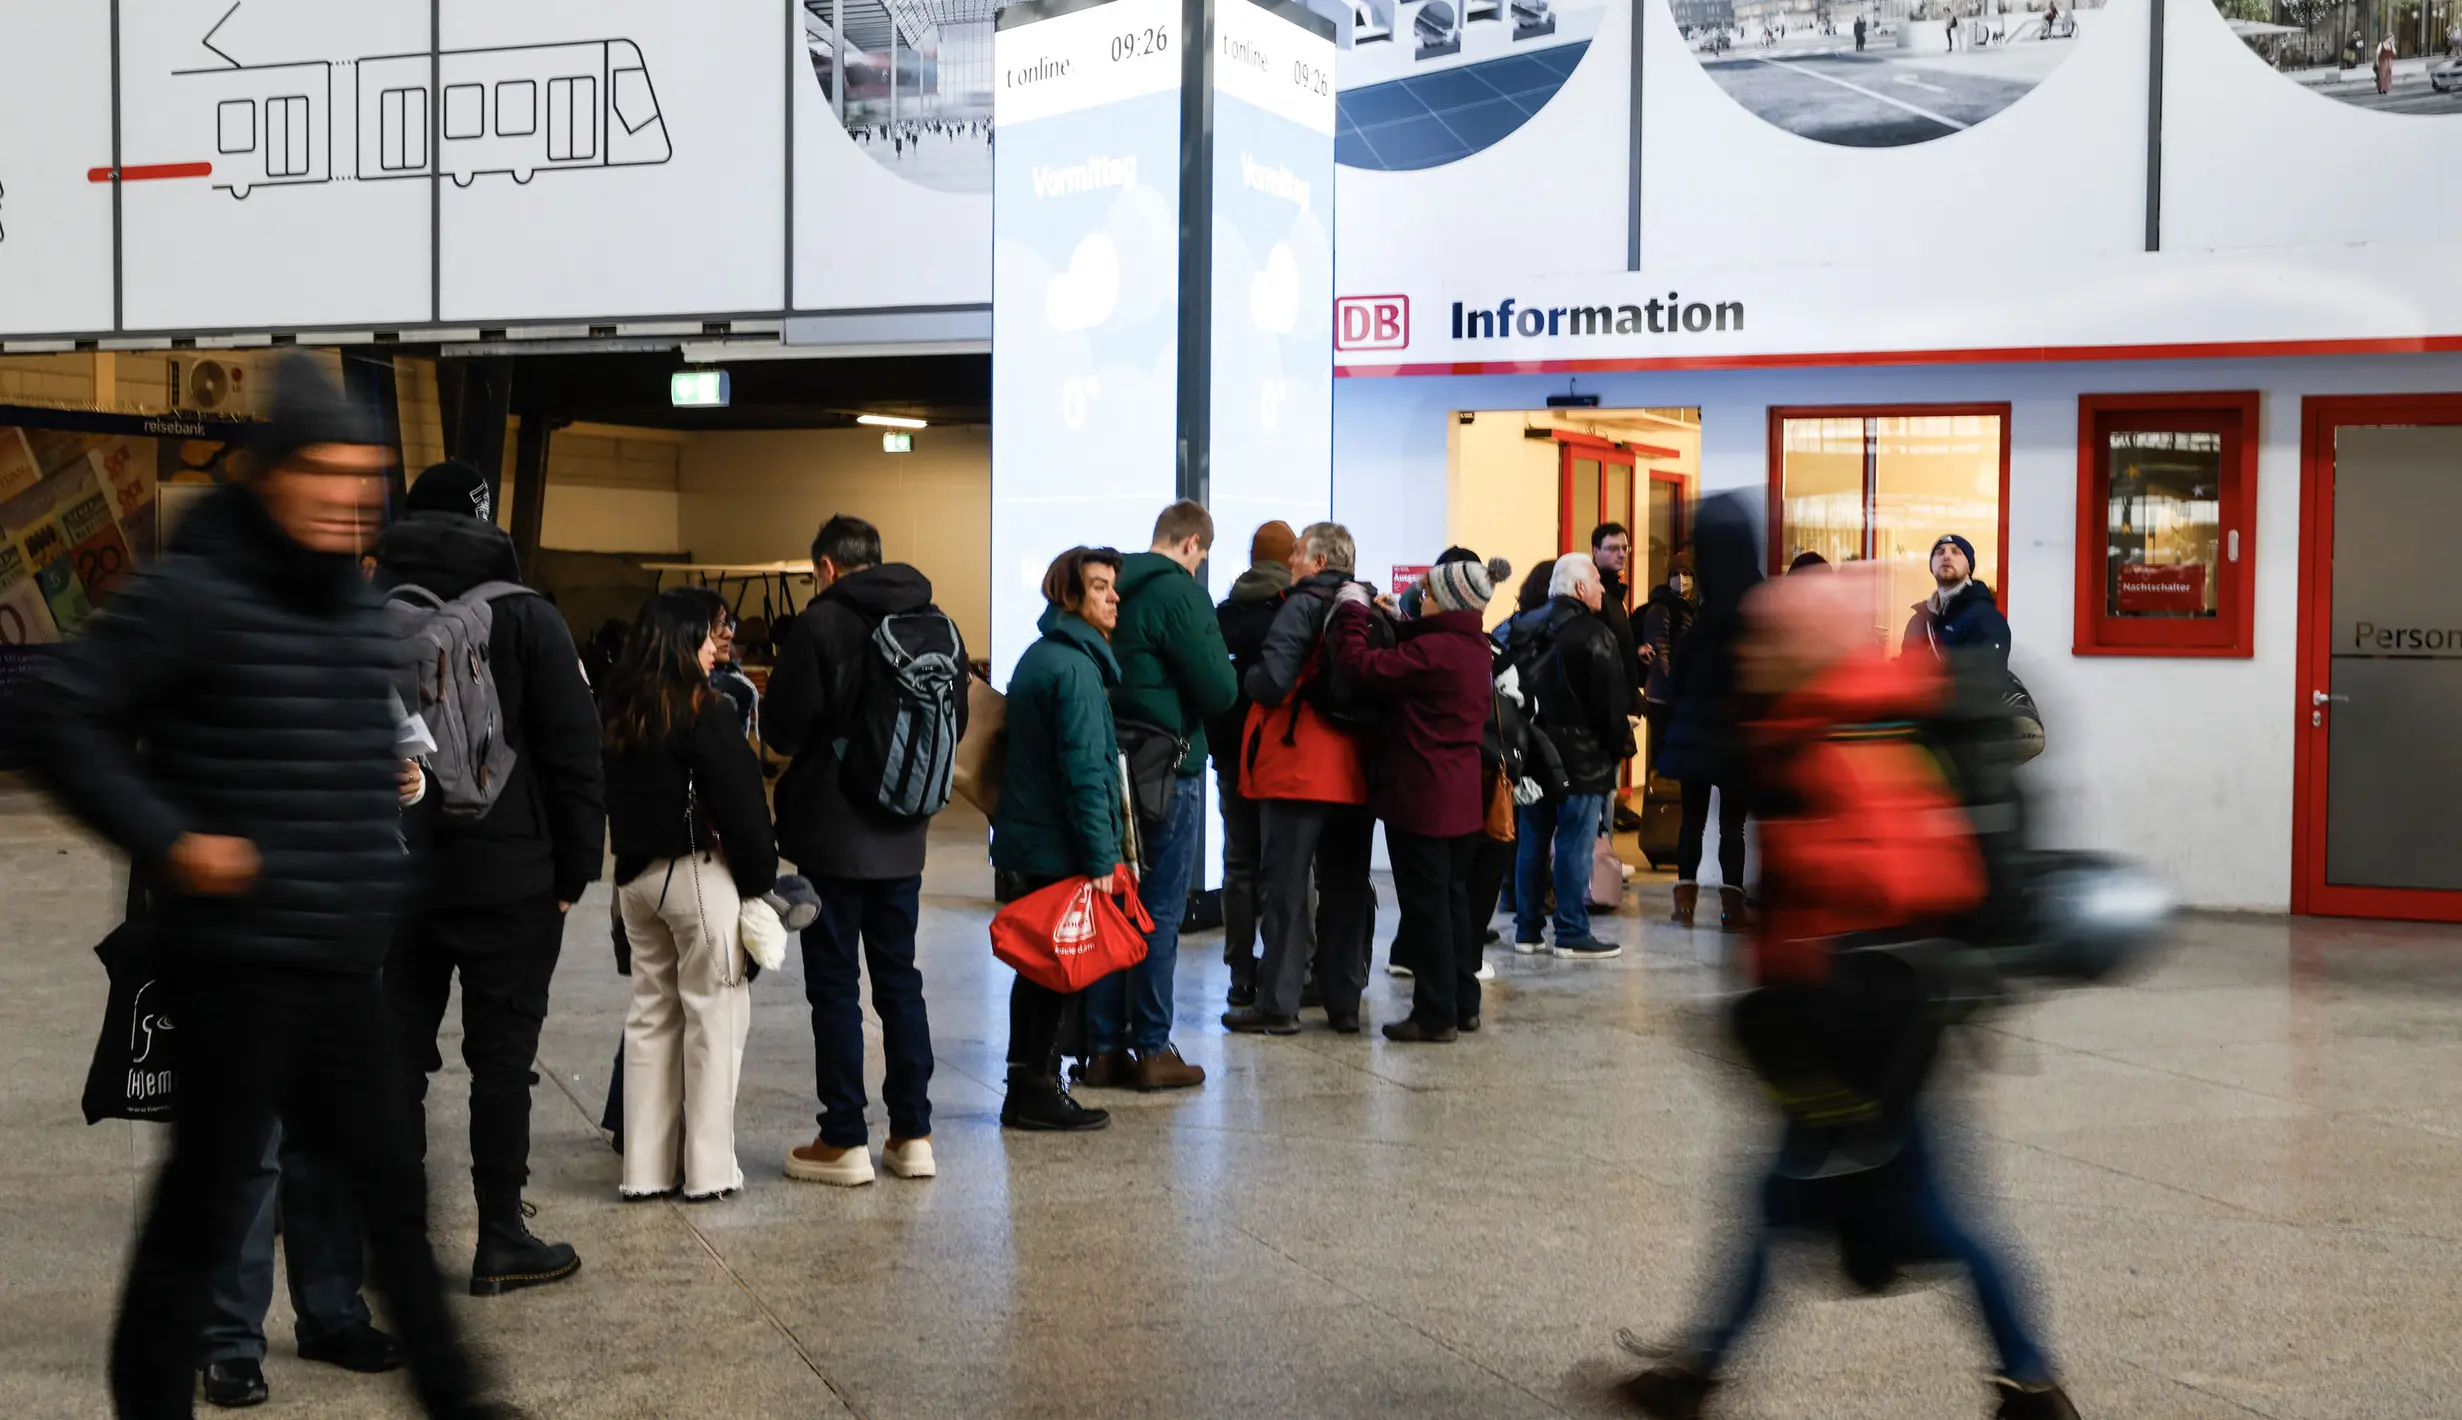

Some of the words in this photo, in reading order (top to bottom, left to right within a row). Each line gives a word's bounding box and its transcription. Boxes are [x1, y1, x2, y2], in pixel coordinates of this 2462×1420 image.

[1111, 25, 1168, 62] 09:26
[1294, 60, 1328, 96] 09:26
[1032, 153, 1137, 200] Vormittag
[1451, 290, 1745, 340] Information
[144, 418, 205, 436] reisebank
[79, 545, 121, 588] 20
[2123, 582, 2191, 593] Nachtschalter
[2355, 621, 2462, 650] Person
